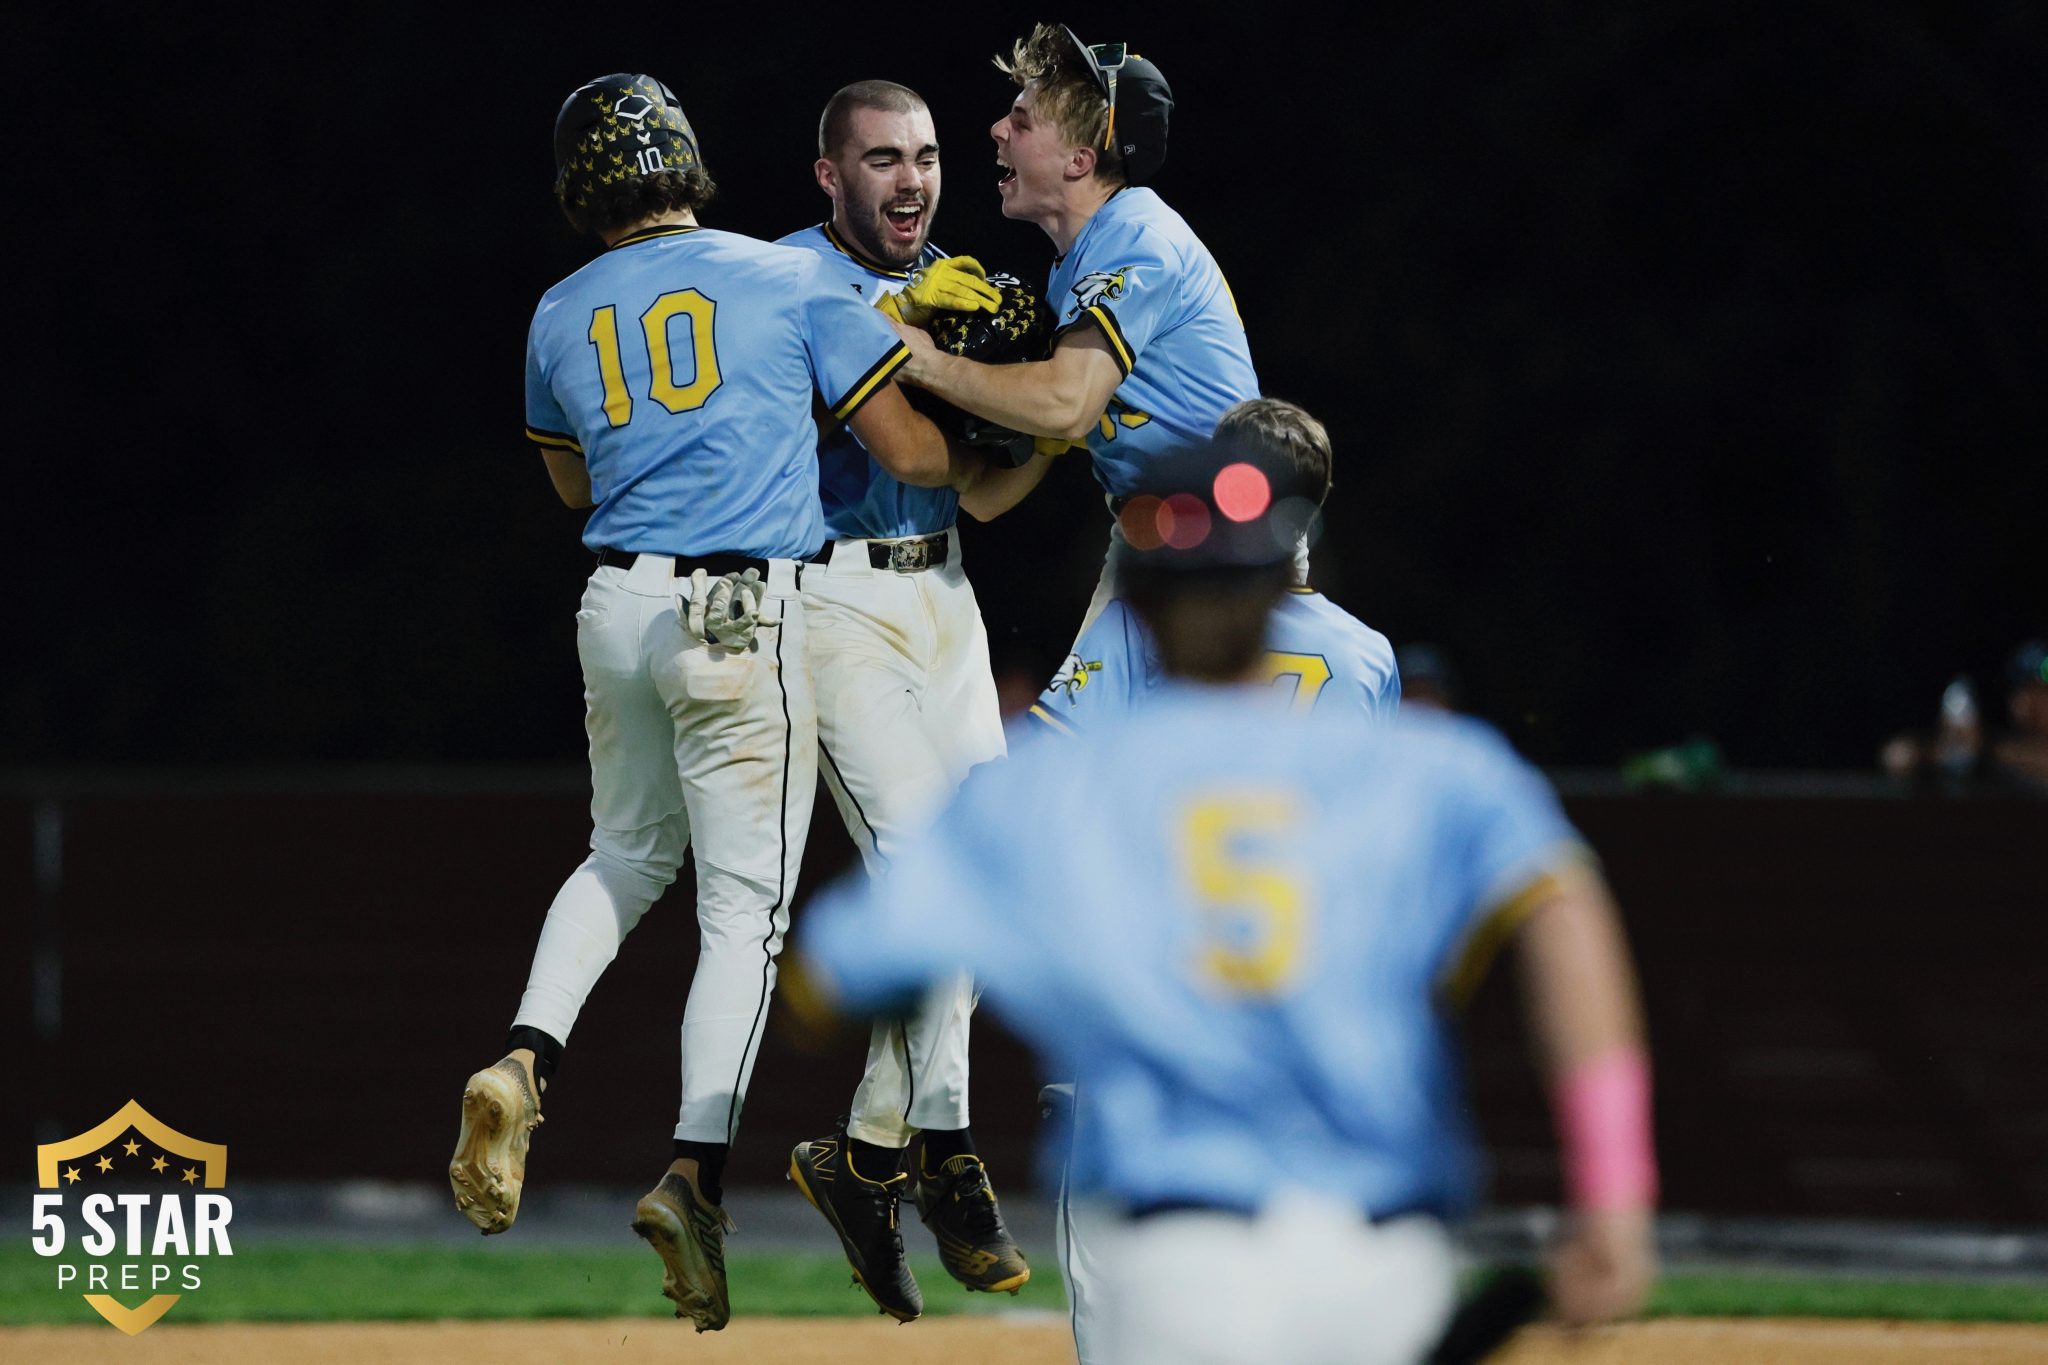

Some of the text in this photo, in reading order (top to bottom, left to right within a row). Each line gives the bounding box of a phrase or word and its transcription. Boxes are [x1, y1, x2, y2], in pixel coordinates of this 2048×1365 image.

[636, 147, 664, 175] 10
[588, 287, 723, 429] 10
[1182, 792, 1309, 994] 5
